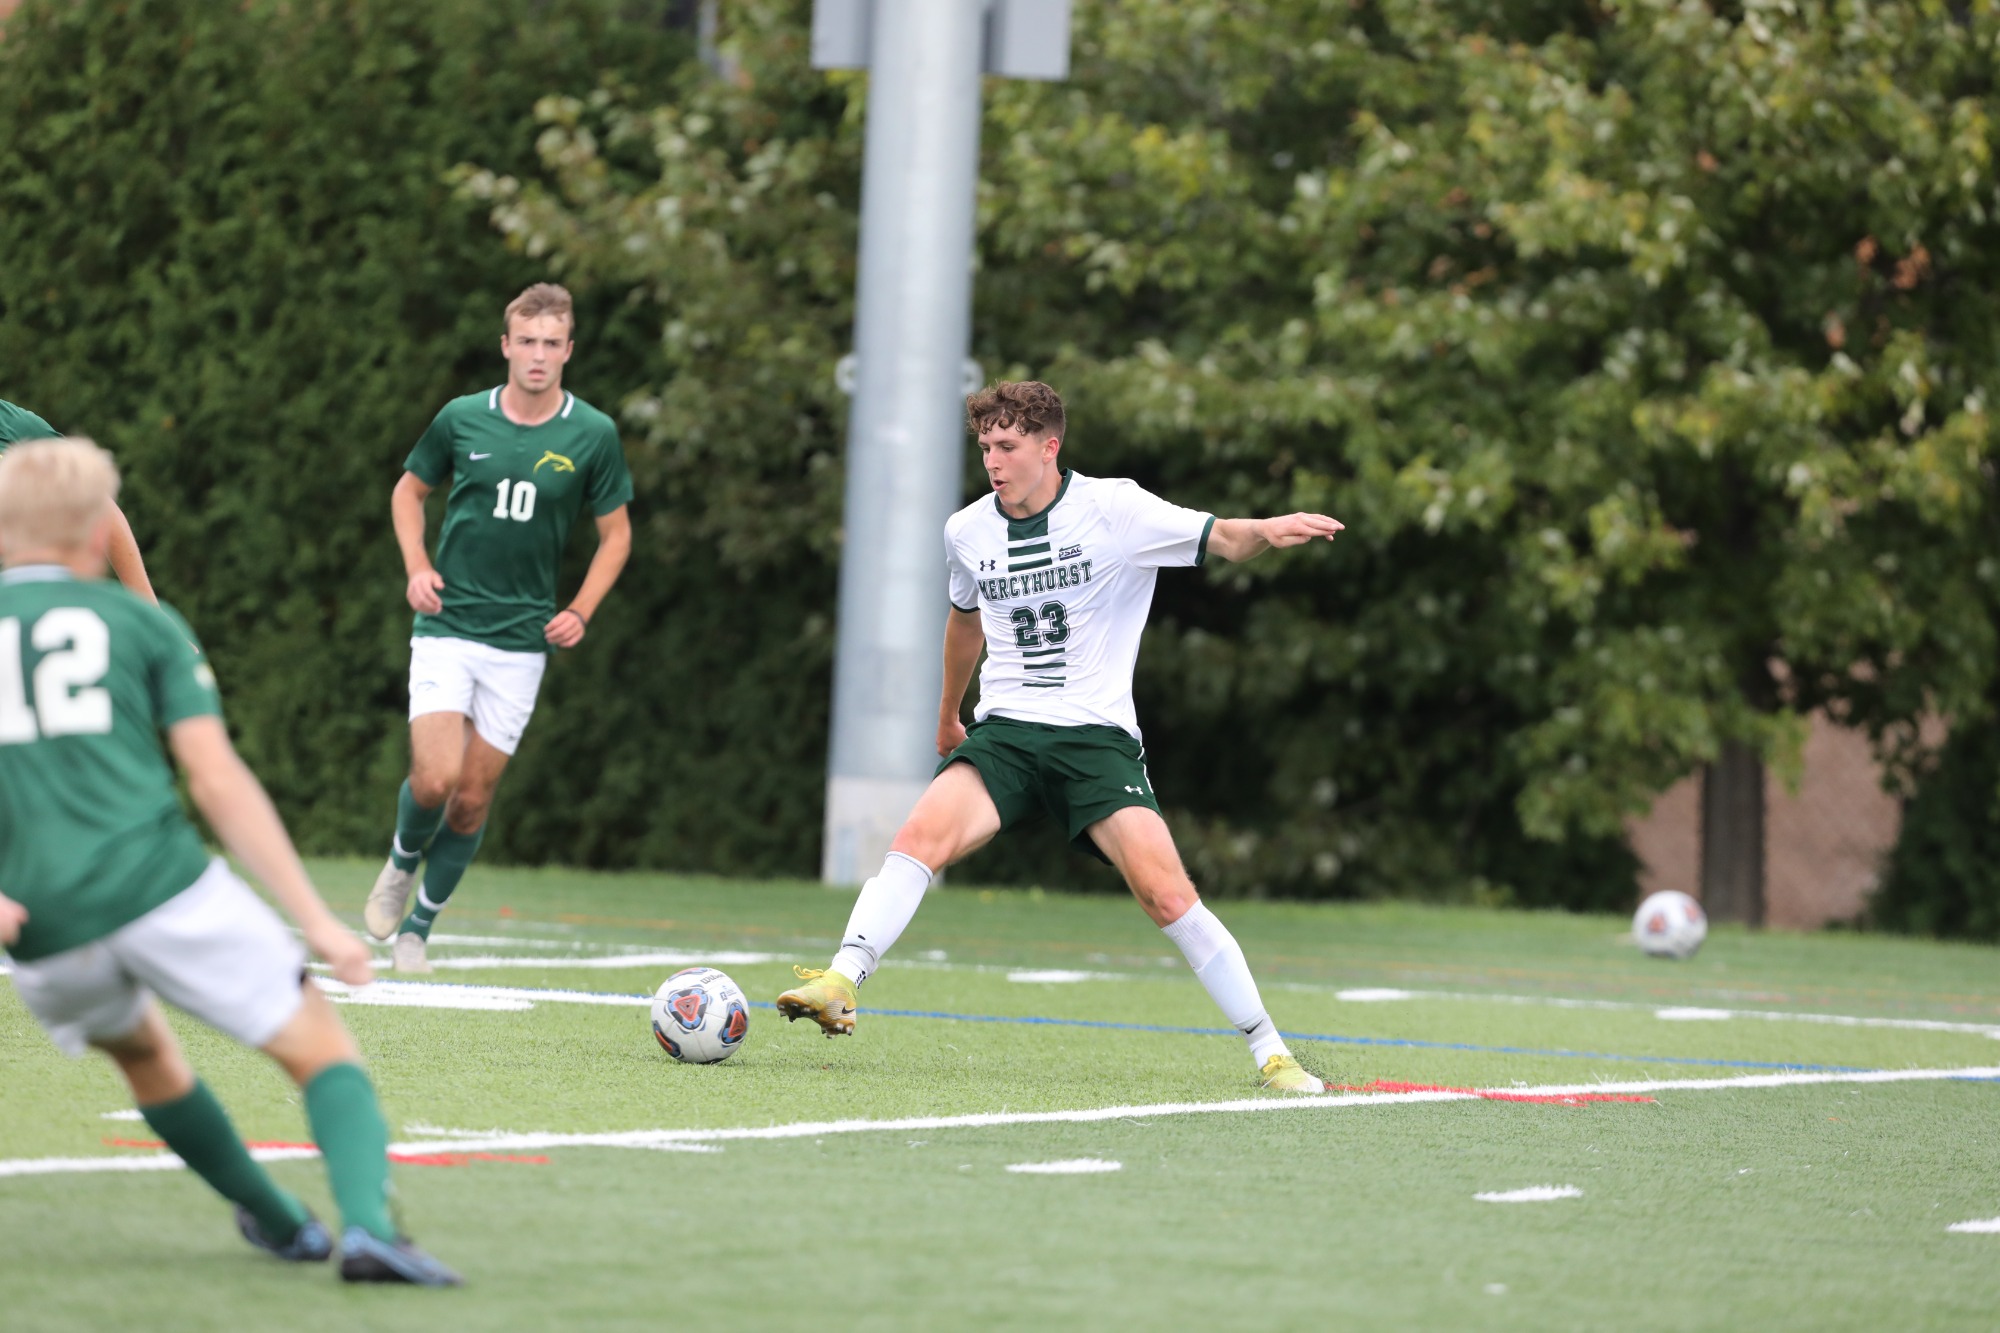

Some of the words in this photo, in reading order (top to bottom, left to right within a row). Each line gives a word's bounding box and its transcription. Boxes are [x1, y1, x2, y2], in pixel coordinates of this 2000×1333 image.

[492, 478, 538, 522] 10
[977, 559, 1092, 601] MERCYHURST
[1009, 600, 1070, 648] 23
[0, 606, 113, 744] 12
